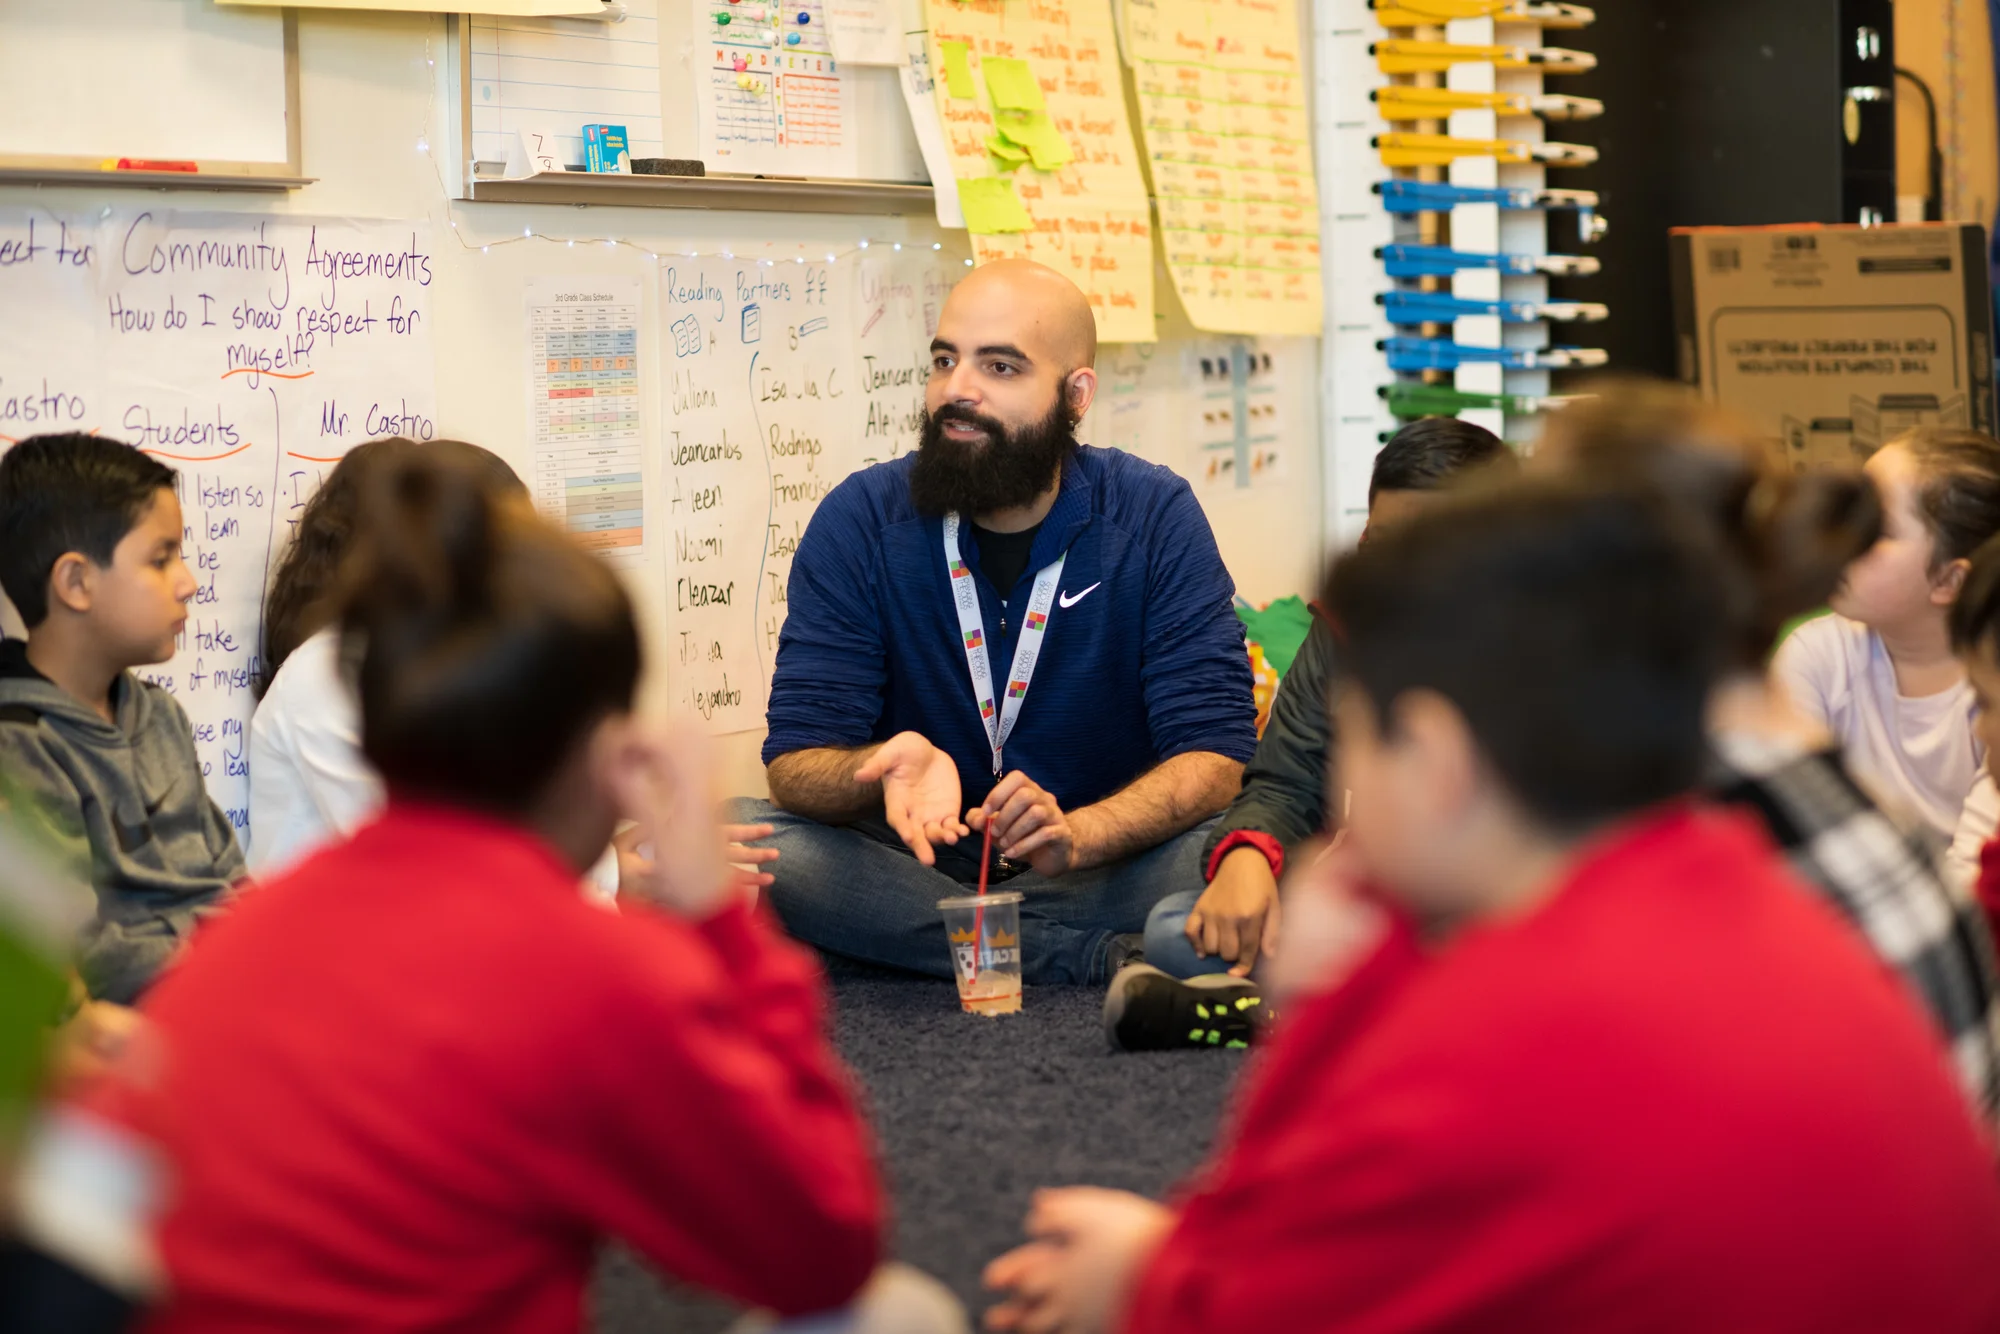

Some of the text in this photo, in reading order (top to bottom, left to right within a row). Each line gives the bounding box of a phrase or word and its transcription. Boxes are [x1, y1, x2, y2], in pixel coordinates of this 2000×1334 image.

[123, 212, 432, 310] Community Agreements
[564, 294, 578, 302] Grade
[579, 293, 592, 302] Class
[592, 293, 614, 302] Schedule
[668, 267, 792, 322] Reading Partners
[108, 293, 421, 347] How do I show respect for
[226, 331, 315, 389] myself?
[123, 404, 240, 447] Students
[320, 398, 433, 441] Mr. Castro
[671, 428, 742, 466] Jeancarlos
[197, 473, 241, 508] listen
[197, 545, 221, 571] be
[195, 618, 240, 652] take
[189, 657, 208, 691] of
